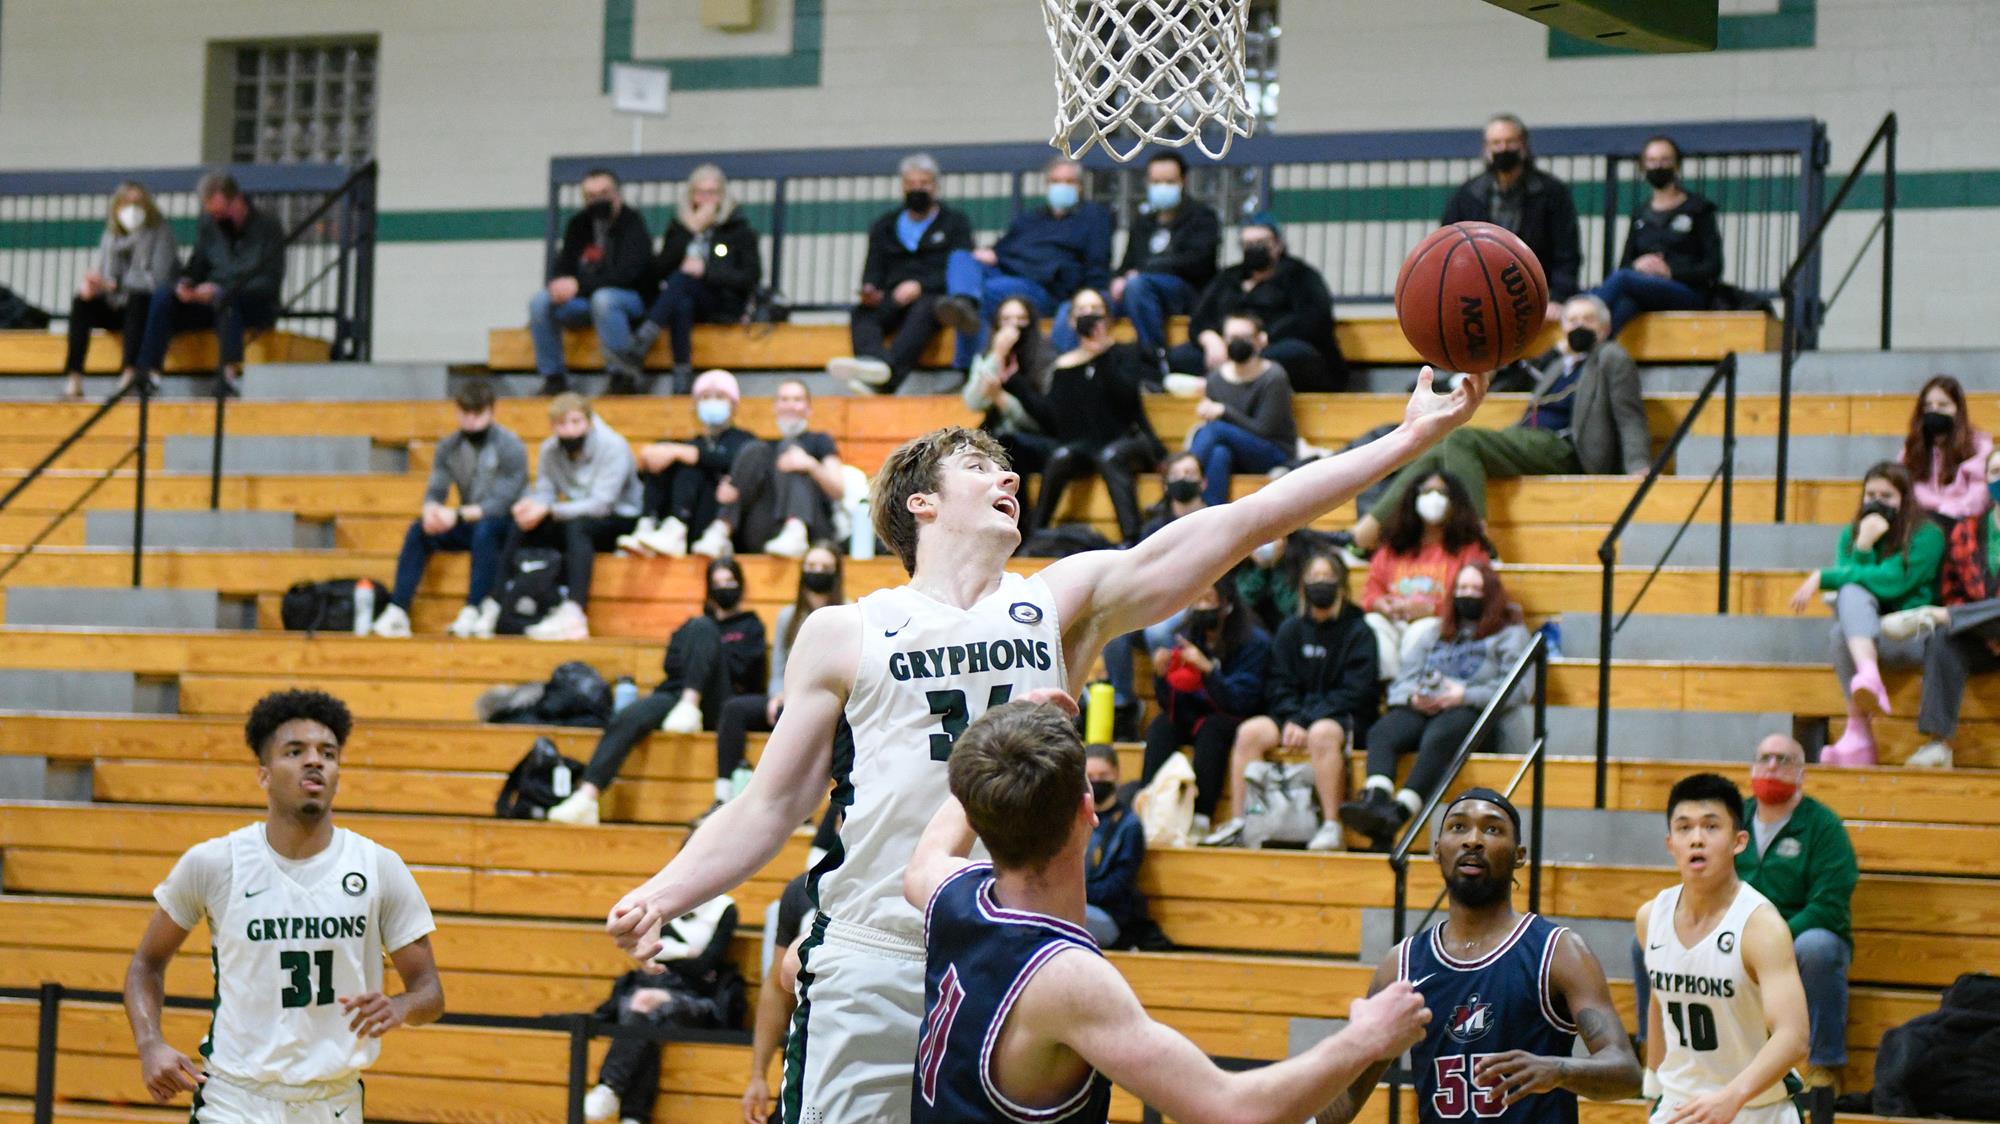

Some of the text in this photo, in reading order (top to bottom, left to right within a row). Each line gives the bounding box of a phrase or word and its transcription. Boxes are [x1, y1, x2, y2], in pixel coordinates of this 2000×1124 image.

[1461, 296, 1489, 361] NC
[1501, 260, 1533, 352] Wil
[889, 638, 1051, 682] GRYPHONS
[246, 915, 367, 941] GRYPHONS
[280, 950, 335, 1008] 31
[1667, 1001, 1718, 1051] 10
[1432, 1054, 1509, 1118] 55
